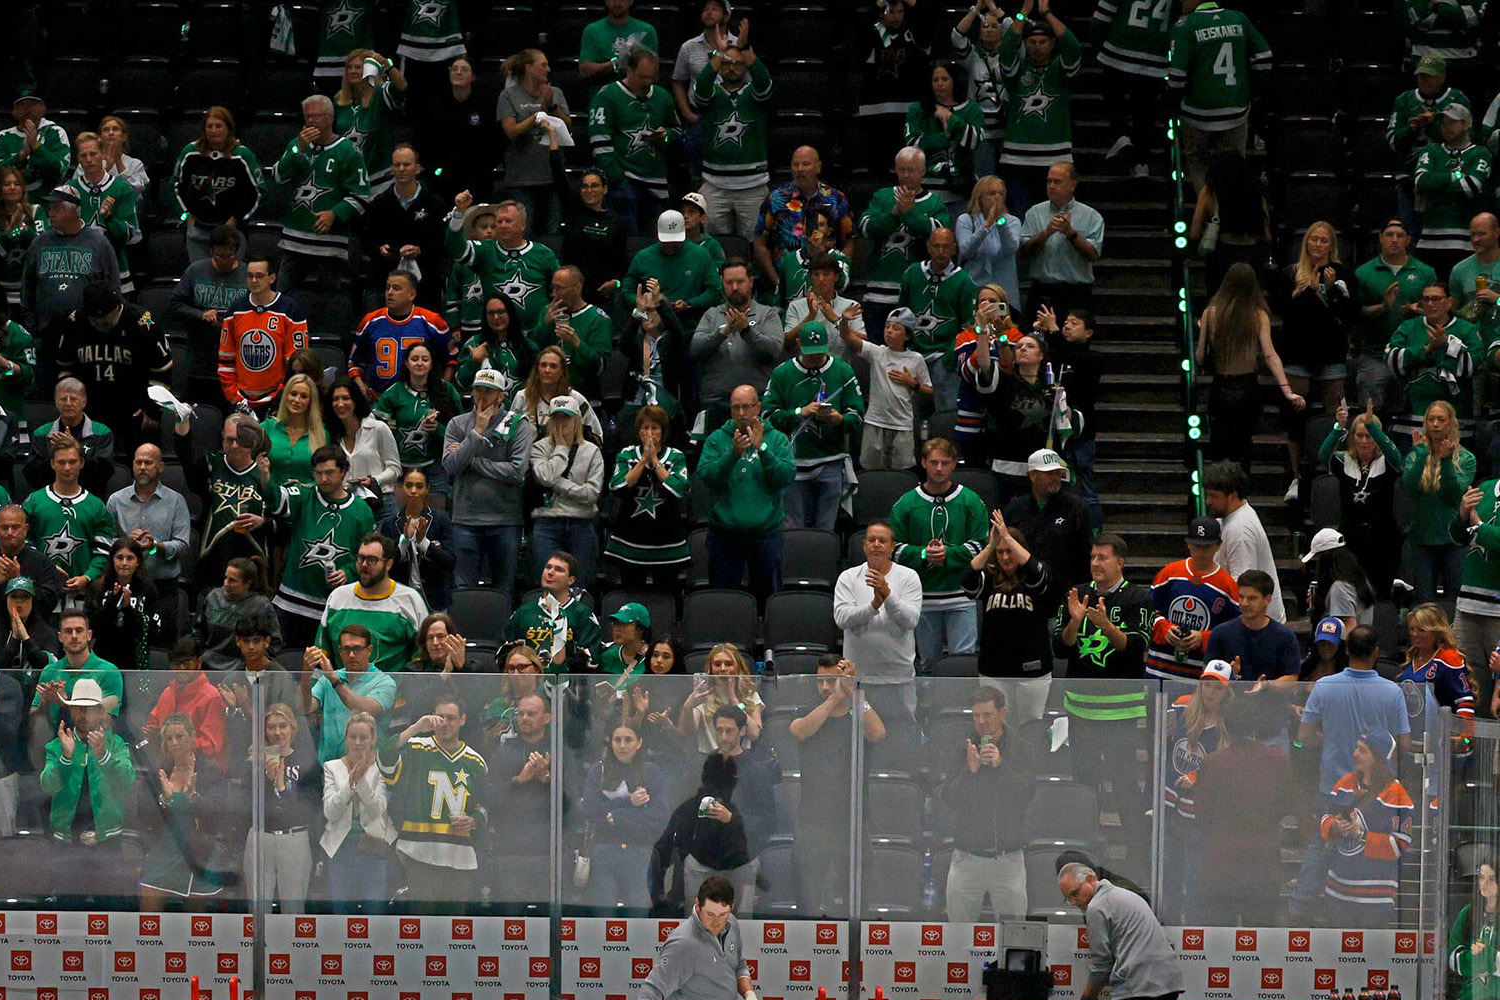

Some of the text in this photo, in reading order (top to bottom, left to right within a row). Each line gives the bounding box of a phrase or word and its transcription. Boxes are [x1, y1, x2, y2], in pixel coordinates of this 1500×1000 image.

[1195, 24, 1244, 41] HEISKANEN
[1212, 42, 1237, 86] 4
[39, 250, 93, 274] STARS
[267, 315, 279, 332] C
[77, 344, 133, 365] DALLAS
[93, 365, 116, 382] 14
[210, 479, 263, 504] STARS
[986, 592, 1034, 613] DALLAS
[1172, 611, 1203, 628] OILERS
[525, 627, 574, 643] STAS
[427, 769, 470, 820] N
